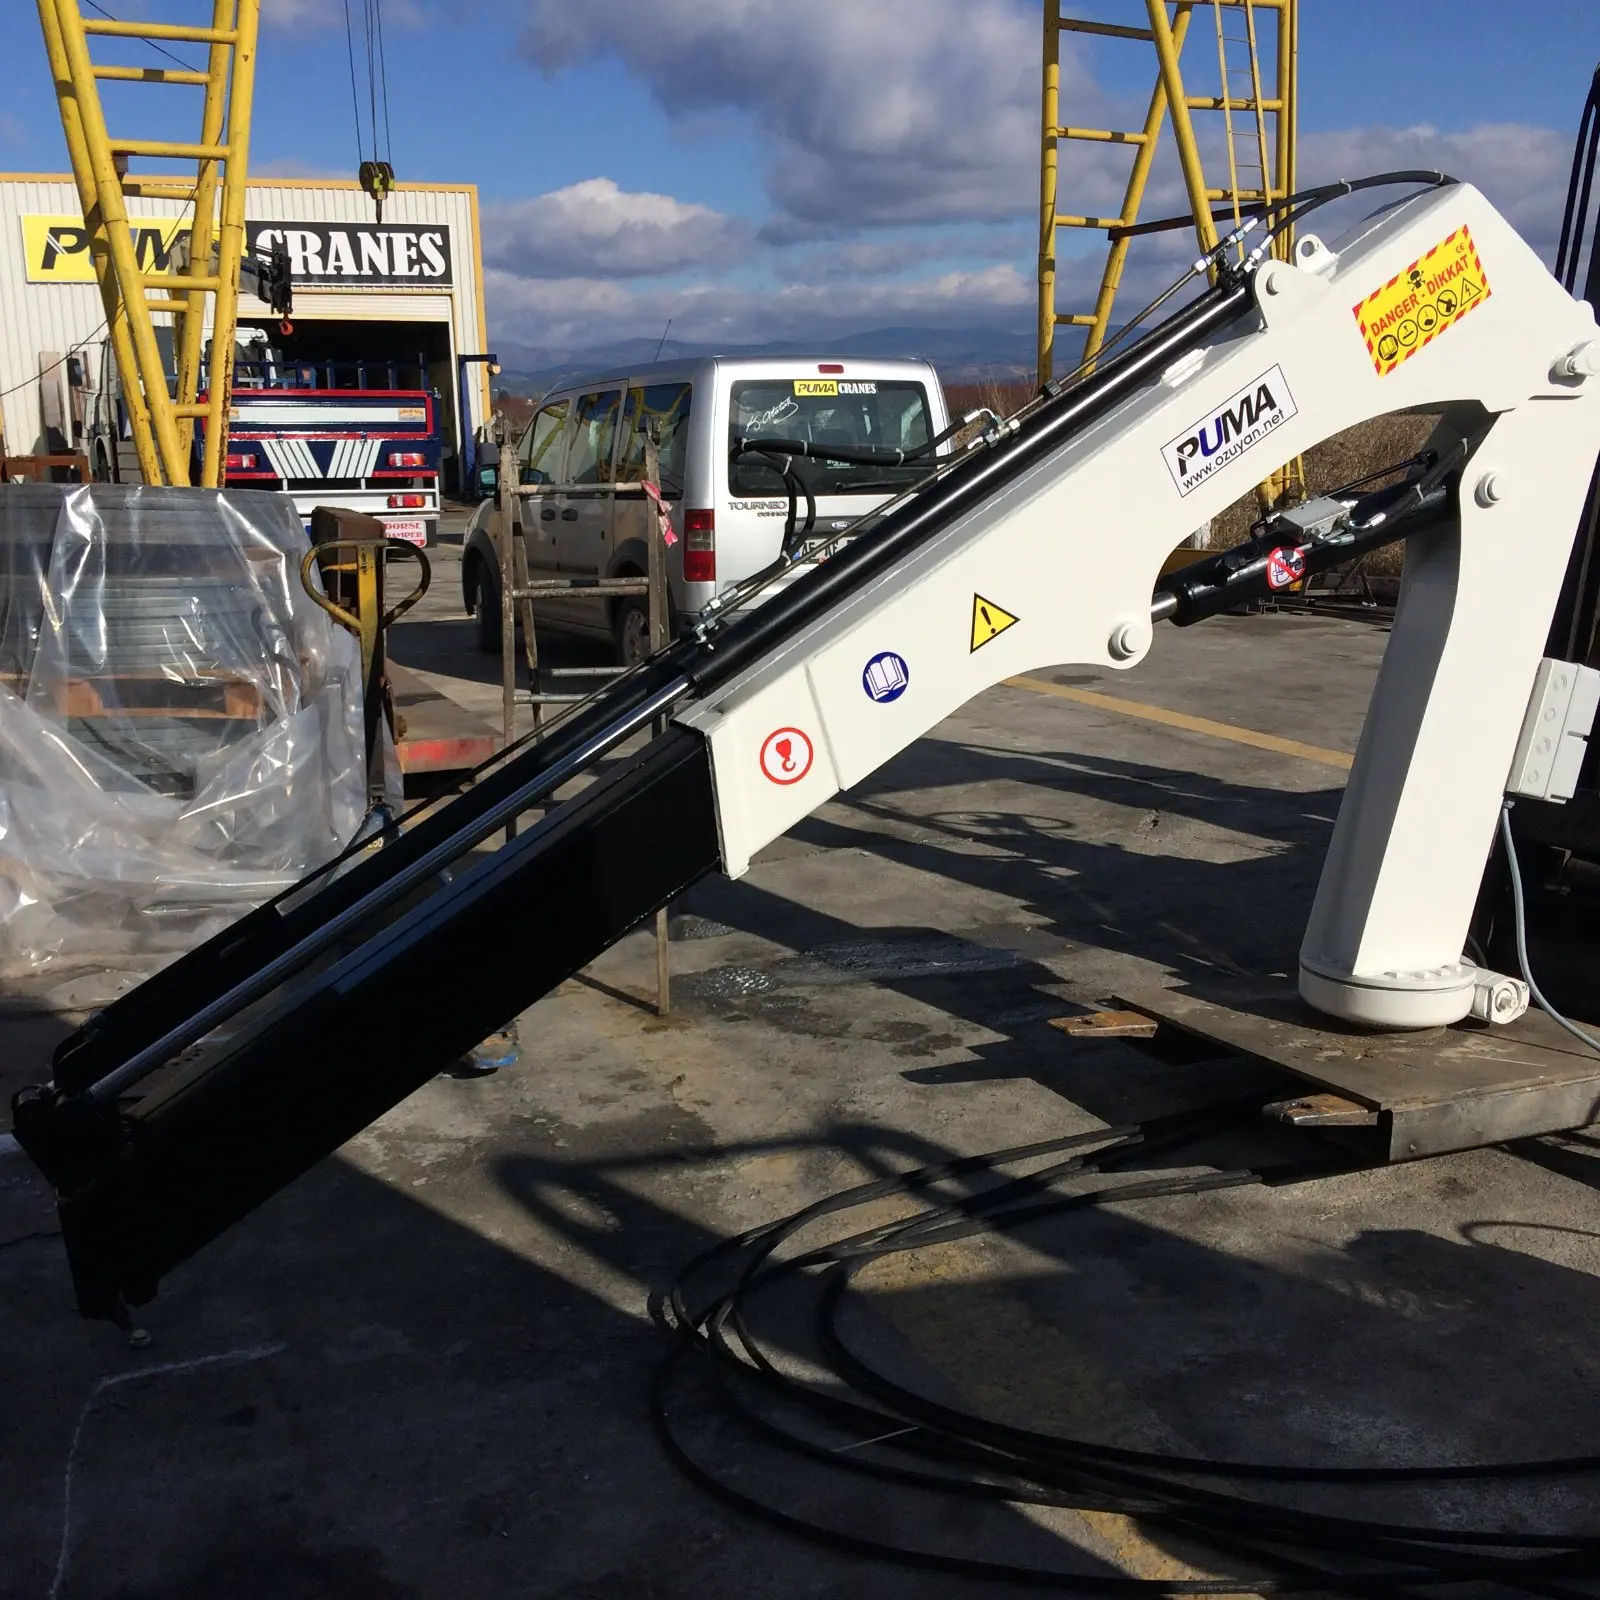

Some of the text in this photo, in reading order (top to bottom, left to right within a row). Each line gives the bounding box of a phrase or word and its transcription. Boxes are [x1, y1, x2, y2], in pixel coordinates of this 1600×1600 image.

[41, 226, 215, 270] PM
[1370, 294, 1420, 337] DANGER
[1426, 254, 1470, 295] DİKKAT
[798, 382, 877, 394] PUMA CRANES
[1176, 383, 1277, 477] PUMA
[1183, 409, 1285, 489] www.ozuyan.net
